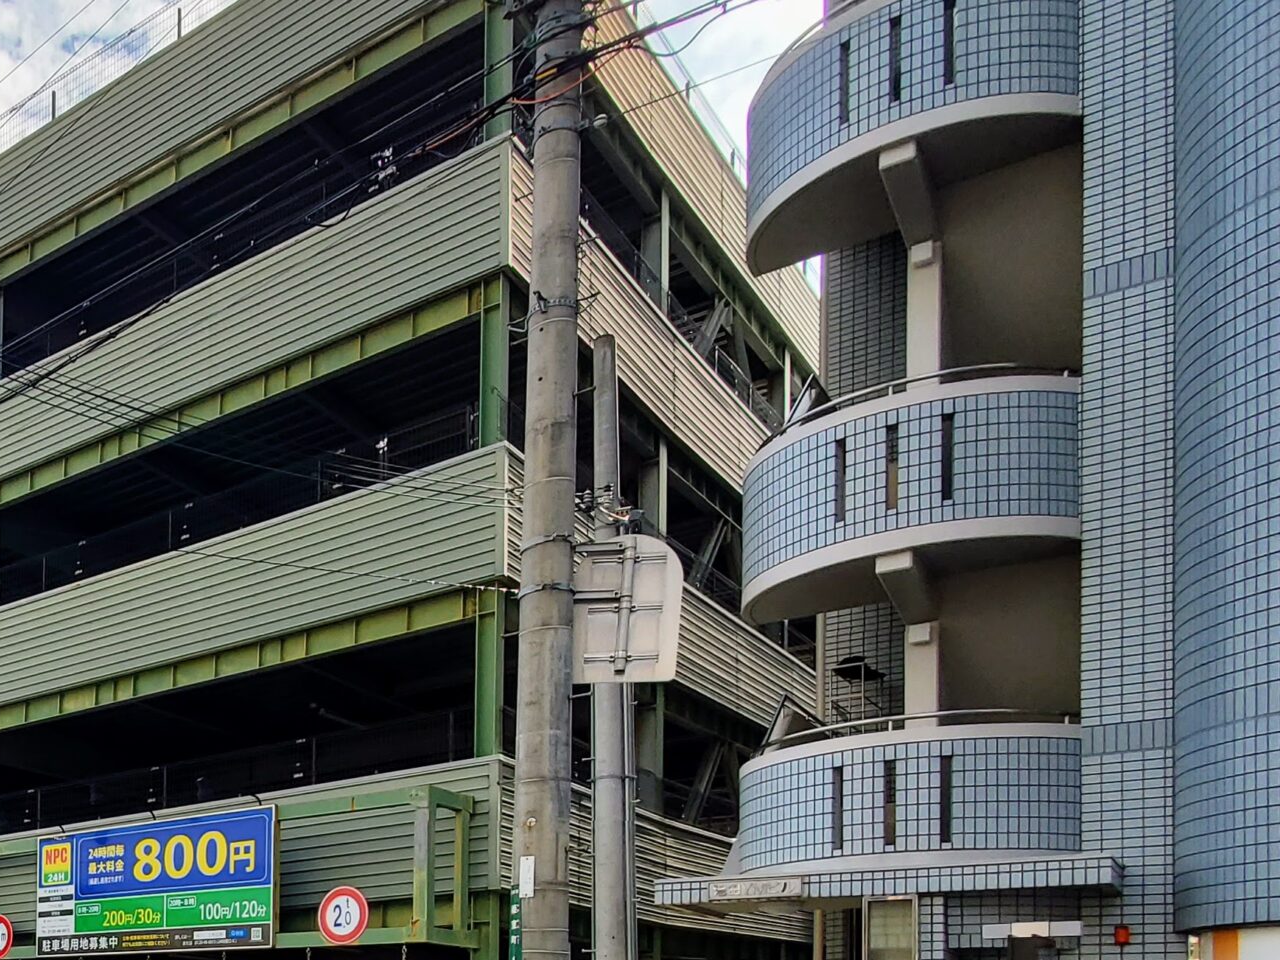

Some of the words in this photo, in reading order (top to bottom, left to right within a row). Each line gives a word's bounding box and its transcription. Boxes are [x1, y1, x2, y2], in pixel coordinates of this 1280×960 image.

[45, 847, 68, 865] NPC
[133, 830, 256, 882] 800円
[88, 859, 125, 874] 最大料金
[47, 872, 65, 882] 24H
[102, 908, 161, 926] 200円/30分
[199, 901, 266, 920] 100円/120分
[41, 936, 118, 952] 駐車場用地募集中
